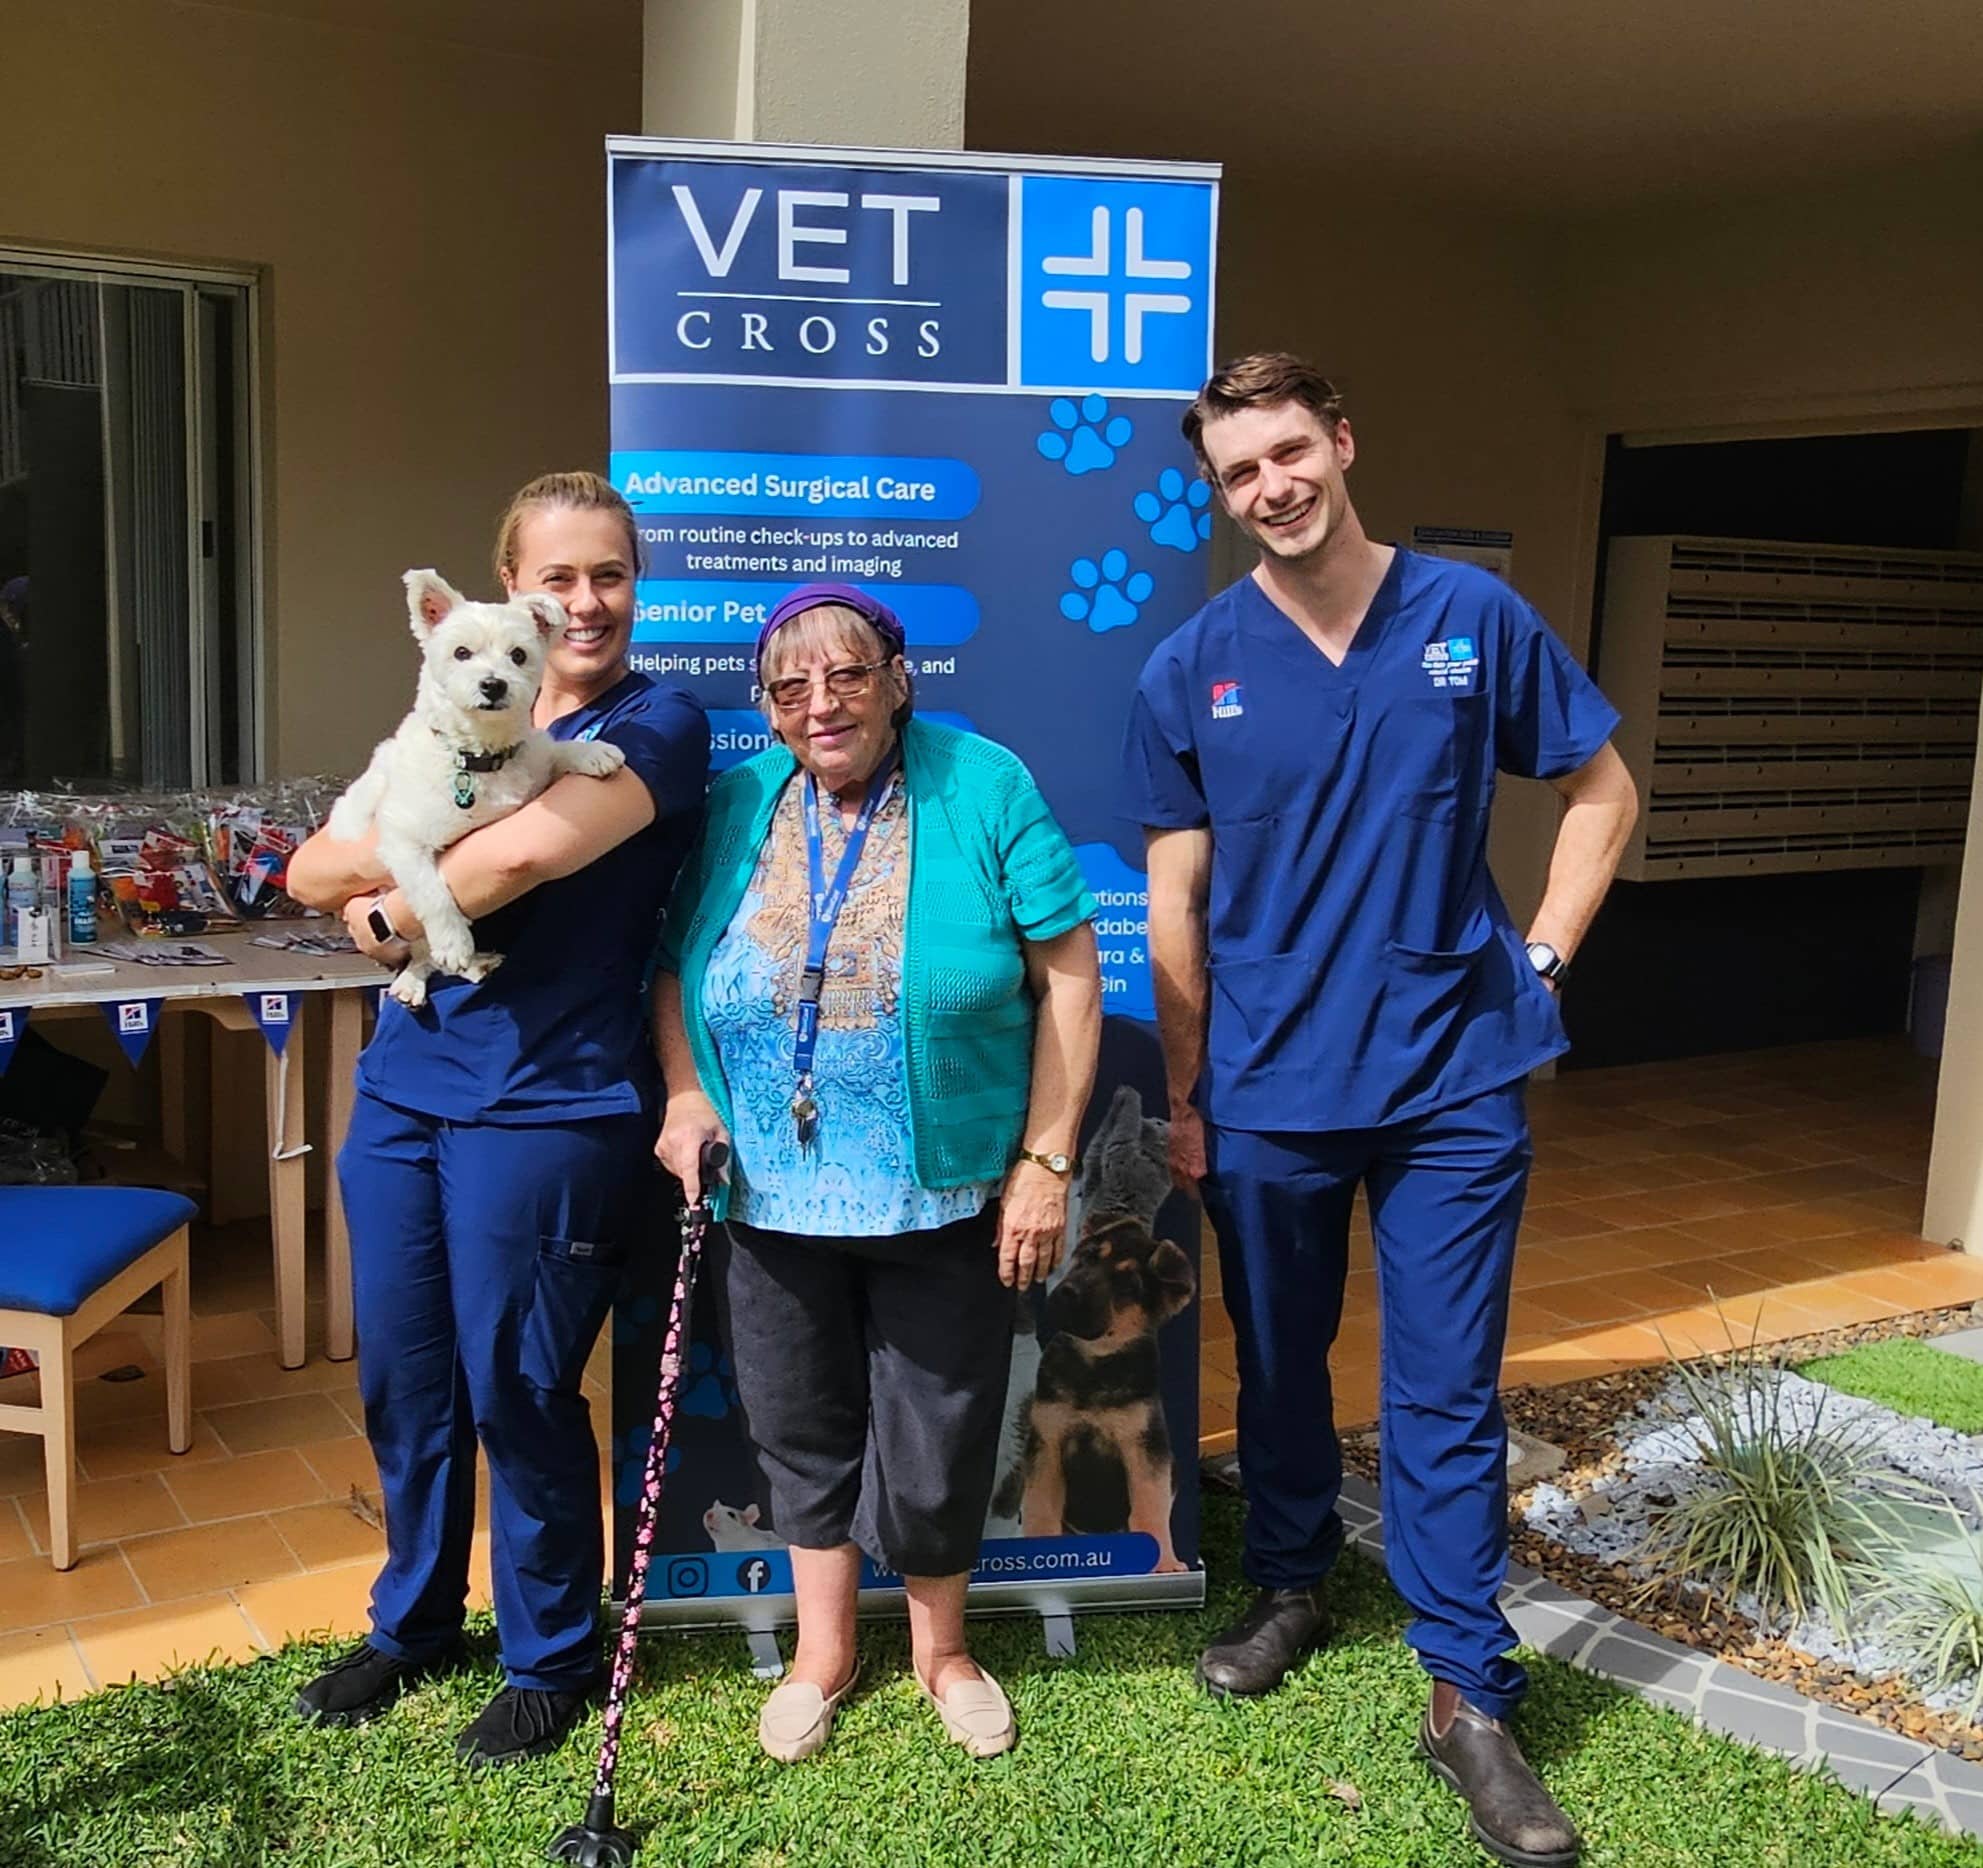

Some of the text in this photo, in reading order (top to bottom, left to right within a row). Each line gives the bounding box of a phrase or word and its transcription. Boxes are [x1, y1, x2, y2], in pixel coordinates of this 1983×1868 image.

[672, 185, 940, 286] VET
[677, 311, 940, 358] CROSS
[625, 471, 936, 504] Advanced Surgical Care
[639, 526, 959, 550] rom routine check-ups to advanced
[686, 553, 903, 578] treatments and imaging
[723, 601, 767, 624] Pet
[630, 653, 701, 675] Helping
[706, 656, 745, 675] pets
[921, 657, 955, 675] and
